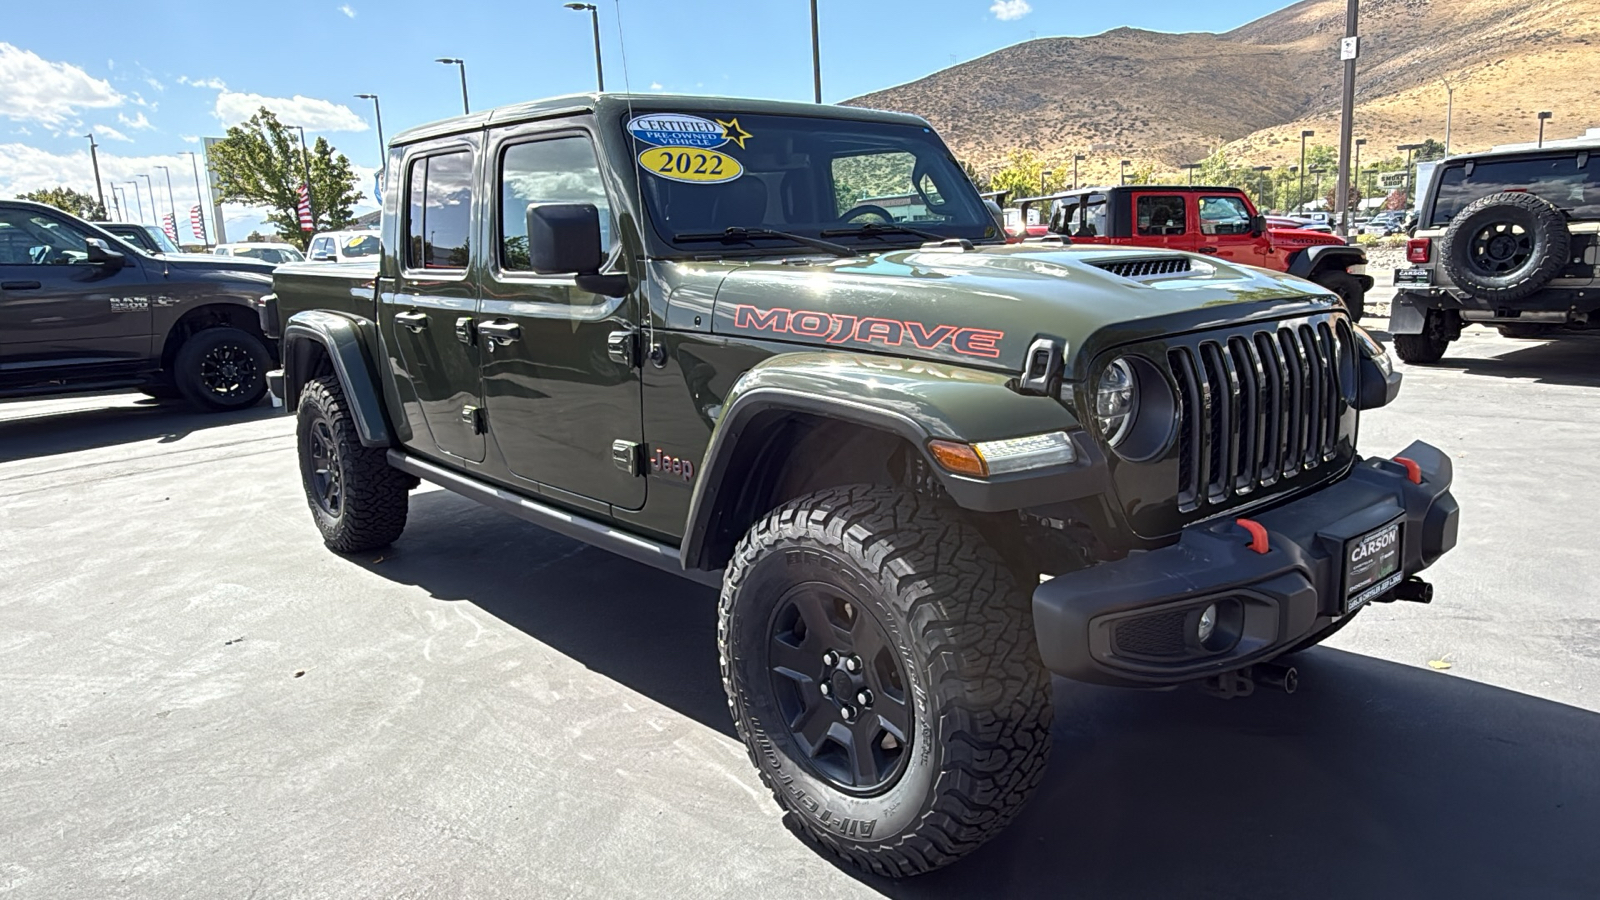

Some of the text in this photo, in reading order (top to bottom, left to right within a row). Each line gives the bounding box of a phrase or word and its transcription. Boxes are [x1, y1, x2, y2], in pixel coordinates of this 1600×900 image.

[637, 119, 716, 132] CERTIFIED
[646, 131, 717, 139] PRE-OWNED
[660, 138, 711, 146] VEHICLE
[659, 151, 723, 175] 2022
[735, 304, 1004, 358] MOJAVE
[650, 448, 695, 482] Jeep
[1351, 530, 1396, 562] CARSON
[751, 716, 877, 839] All-Terrain
